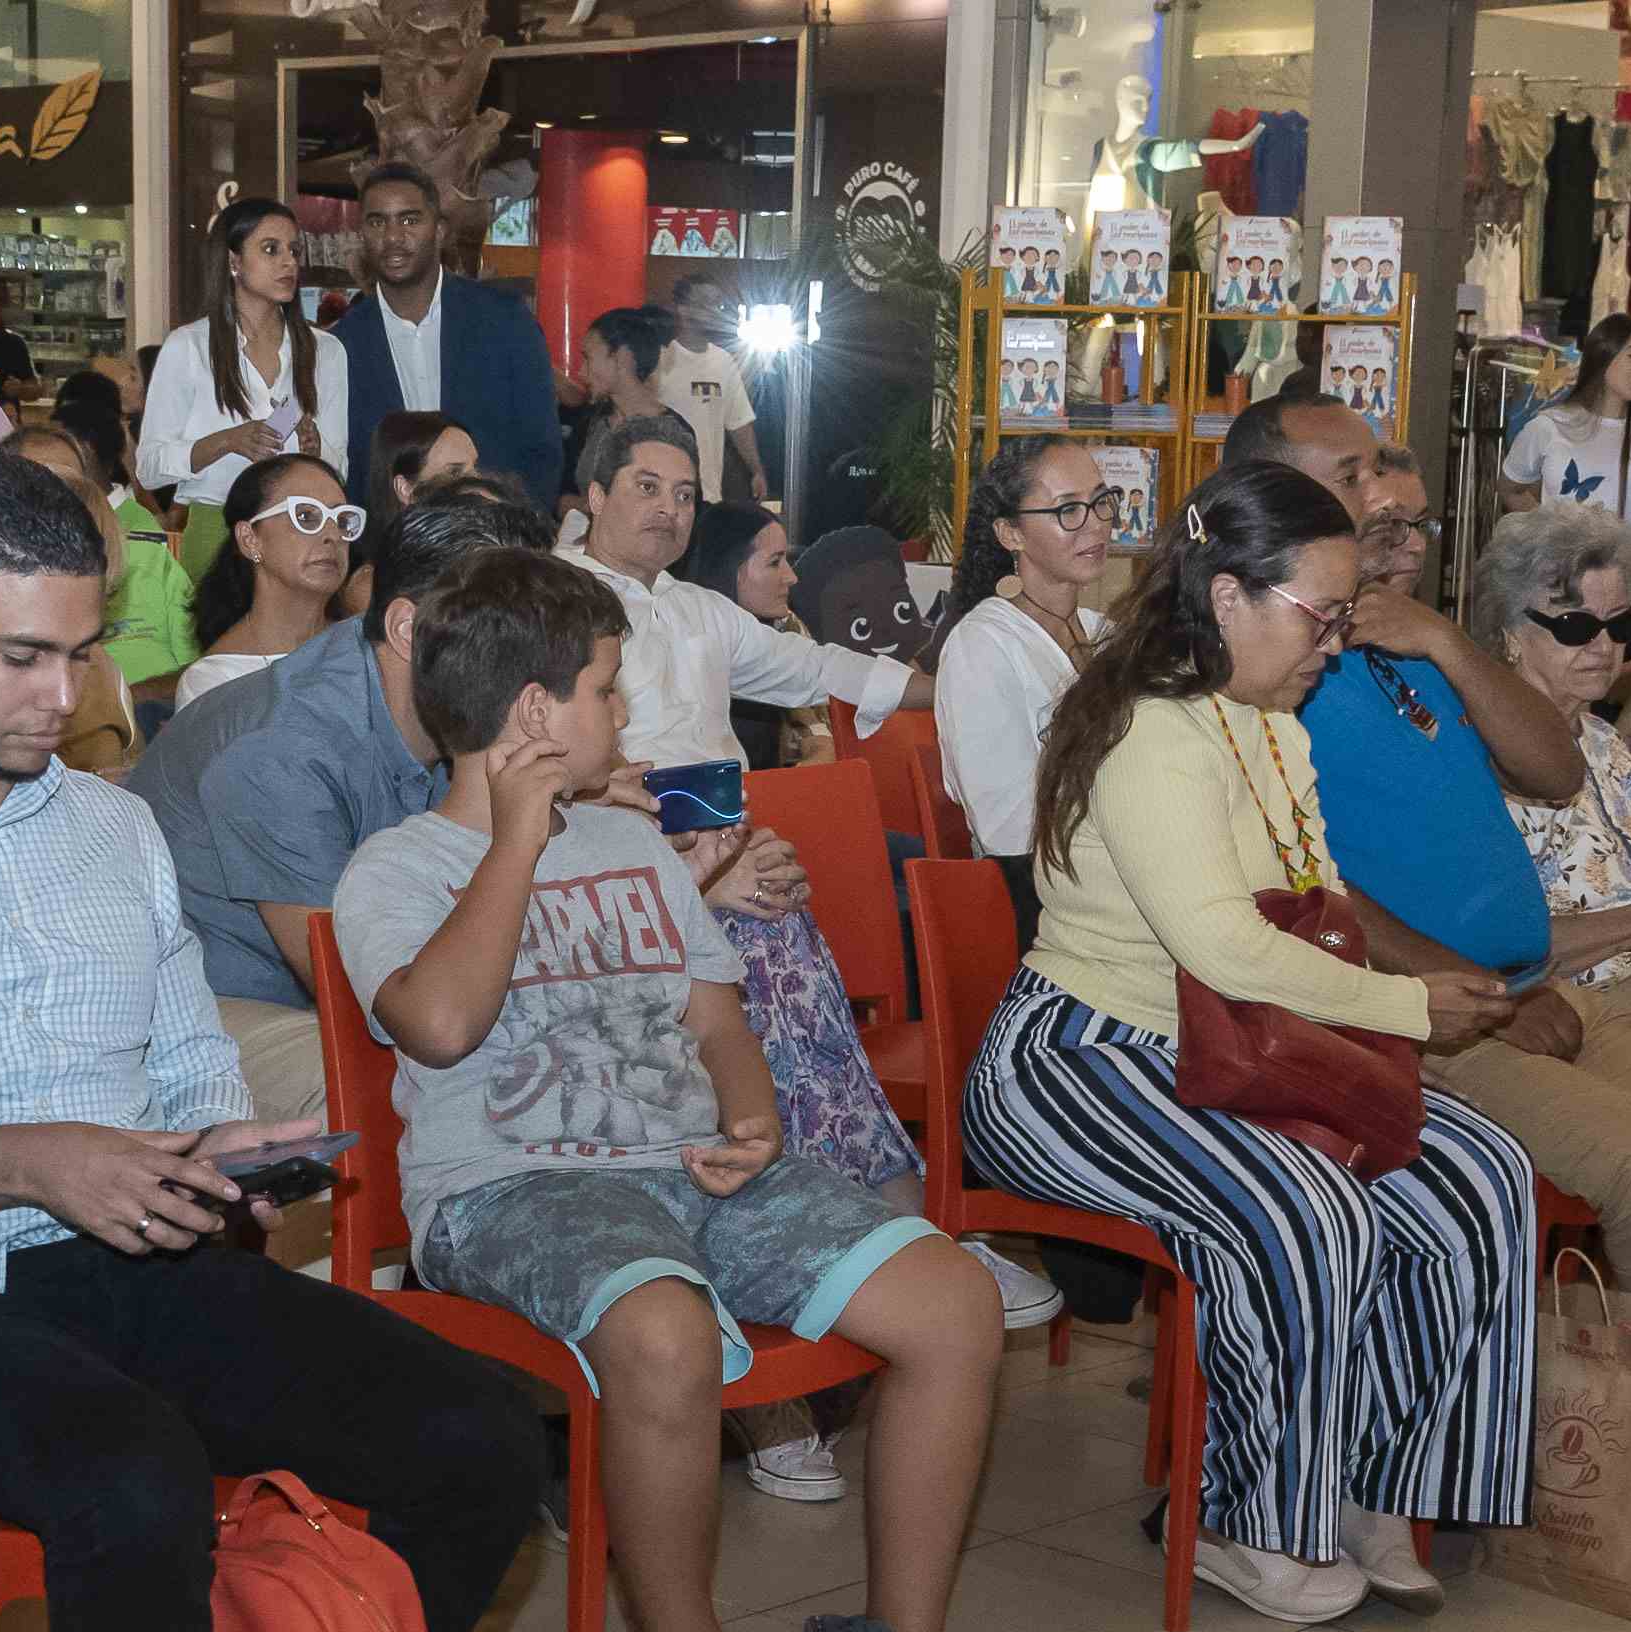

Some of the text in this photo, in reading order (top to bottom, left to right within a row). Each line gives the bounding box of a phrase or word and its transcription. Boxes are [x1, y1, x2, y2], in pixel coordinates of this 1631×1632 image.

[843, 160, 921, 198] PURO CAFÉ
[512, 872, 683, 978] ARVEL
